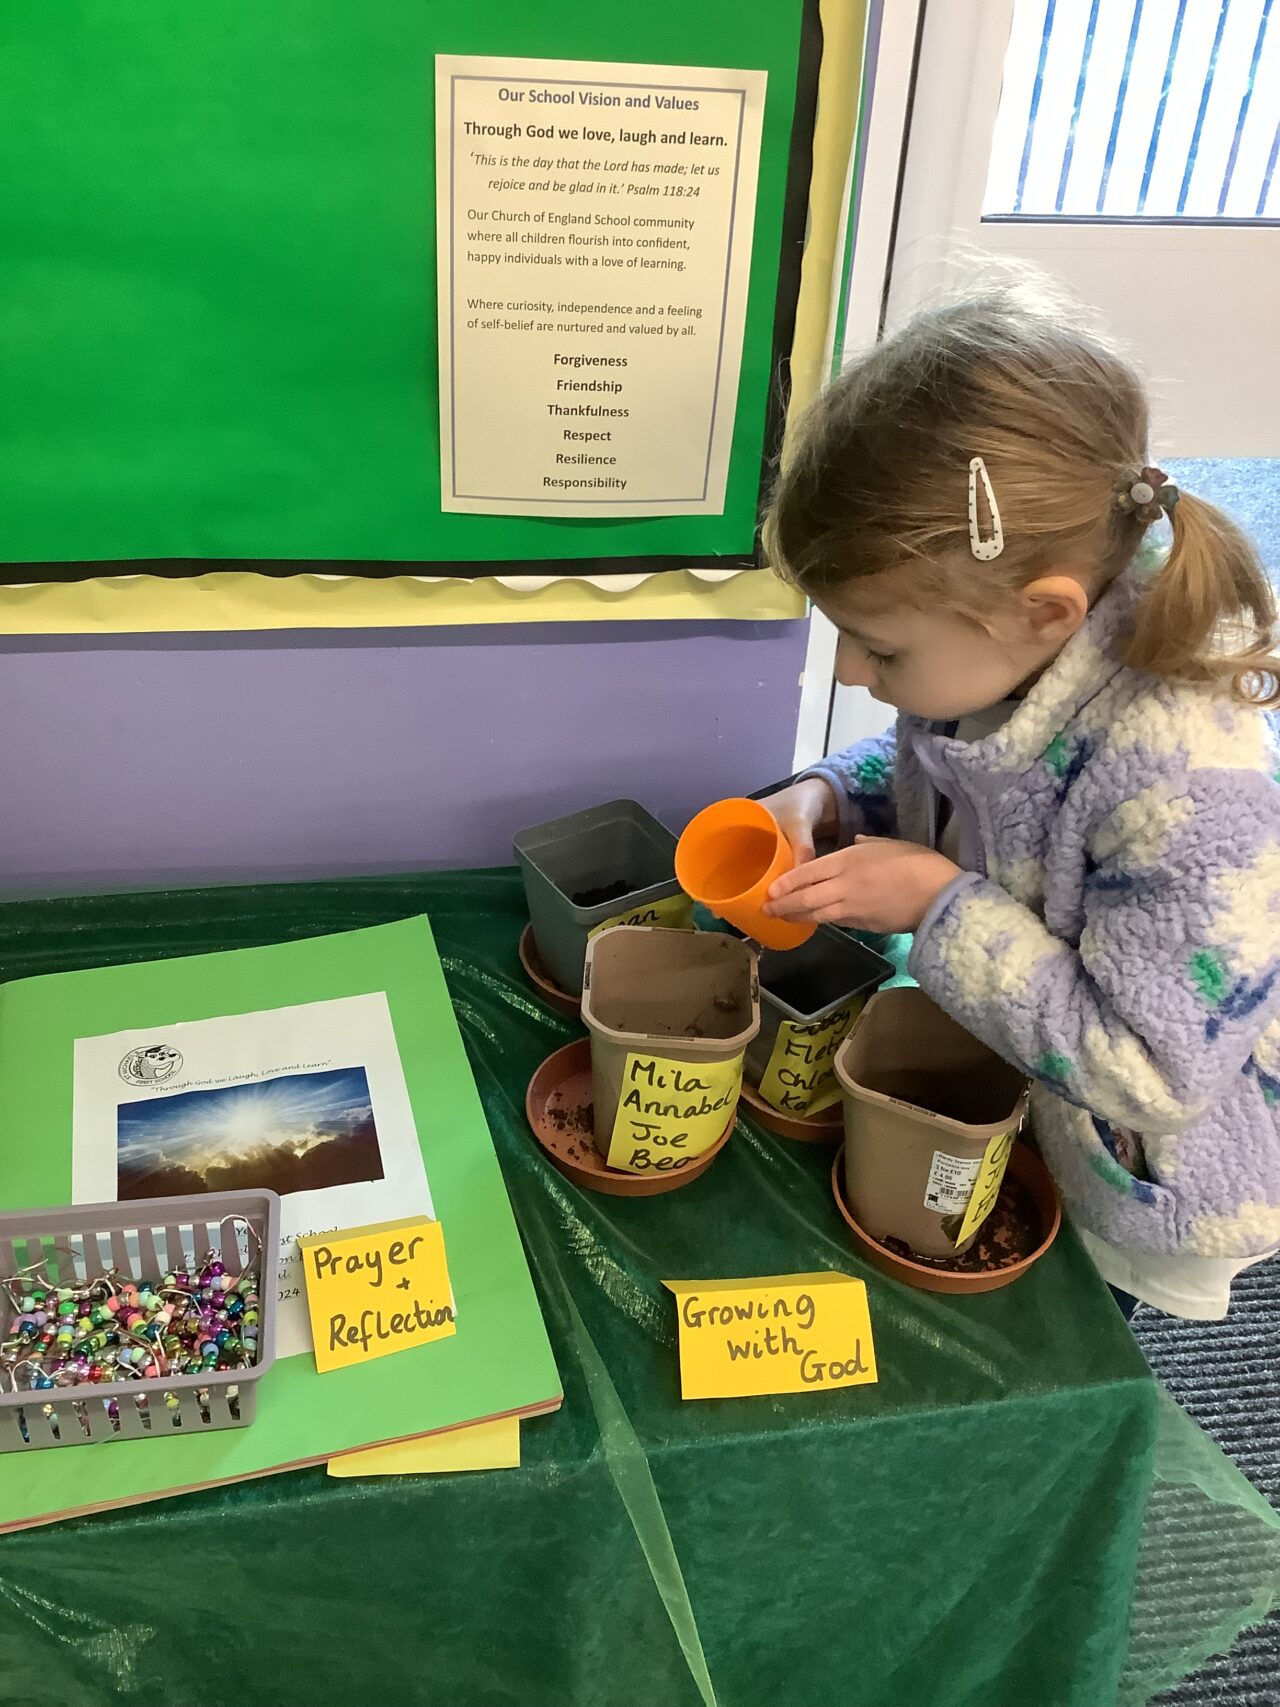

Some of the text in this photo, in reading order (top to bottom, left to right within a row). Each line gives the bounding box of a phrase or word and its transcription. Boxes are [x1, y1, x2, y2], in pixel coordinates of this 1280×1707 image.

[498, 88, 699, 111] Our School Vision and Values
[463, 121, 728, 147] Through God we love, laugh and learn.
[470, 151, 720, 176] 'This is the day that the Lord has made; let us
[488, 178, 700, 198] rejoice and be glad in it.' Psalm 118:24
[467, 209, 695, 231] Our Church of England School community
[467, 229, 690, 251] where all children flourish into confident,
[467, 250, 687, 272] happy individuals with a love of learning.
[467, 298, 703, 319] Where curiosity, independence and a feeling
[467, 317, 696, 337] of self-belief are nurtured and valued by all.
[554, 353, 628, 368] Forgiveness
[556, 379, 623, 395] Friendship
[547, 404, 630, 418] Thankfulness
[563, 429, 612, 443] Respect
[555, 453, 617, 465] Resilience
[543, 476, 627, 491] Responsibility
[194, 1077, 214, 1087] God
[261, 1068, 281, 1076] Love
[281, 1064, 301, 1072] and
[630, 1060, 712, 1093] Mila
[623, 1088, 733, 1119] Annabel
[630, 1120, 688, 1148] Joe
[314, 1236, 424, 1287] Prayer
[683, 1293, 815, 1330] Growing
[330, 1299, 454, 1351] Reflection
[726, 1331, 804, 1361] with
[799, 1339, 869, 1383] God
